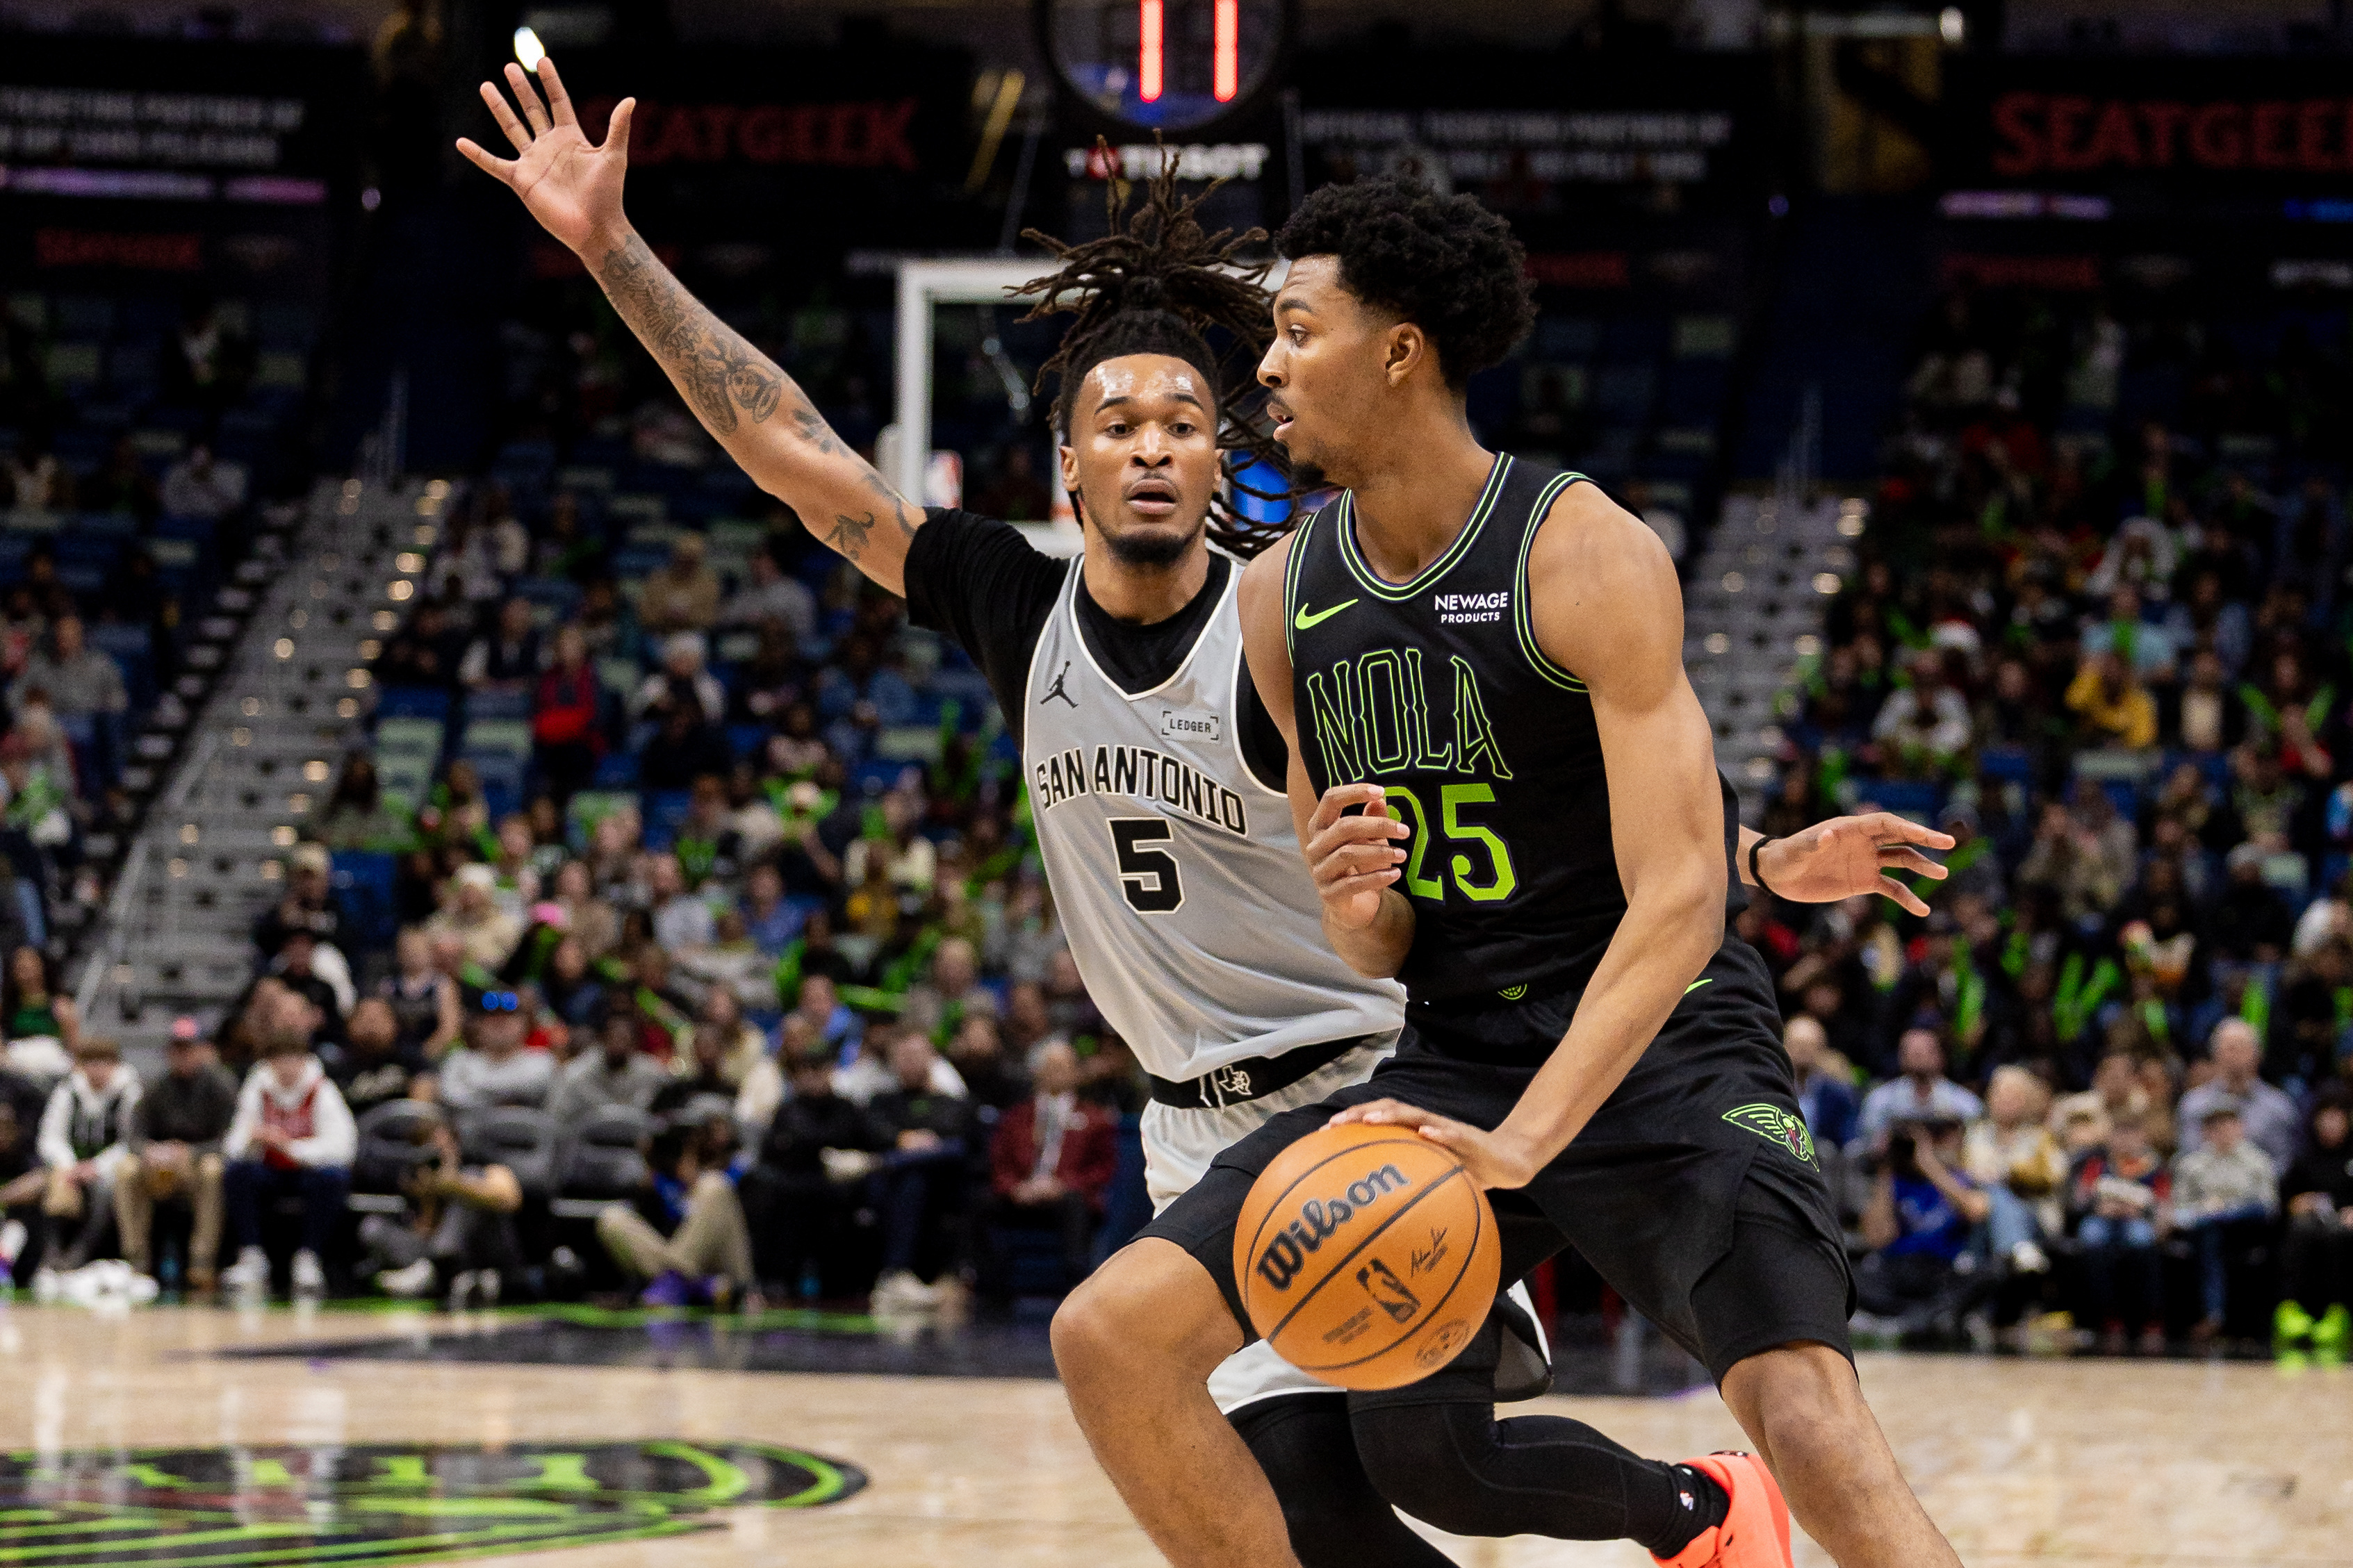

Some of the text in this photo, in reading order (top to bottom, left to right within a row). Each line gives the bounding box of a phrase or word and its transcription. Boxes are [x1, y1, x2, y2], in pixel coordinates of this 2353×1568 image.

[1140, 0, 1238, 102] 11
[1992, 90, 2353, 176] SEATGEE
[1434, 592, 1508, 611] NEWAGE
[1441, 612, 1500, 623] PRODUCTS
[1170, 718, 1211, 733] LEDGER
[1307, 647, 1513, 788] NOLA
[1034, 743, 1249, 838] SAN ANTONIO
[1106, 816, 1186, 915] 5
[1384, 783, 1516, 901] 25
[1256, 1163, 1411, 1292] Wilson
